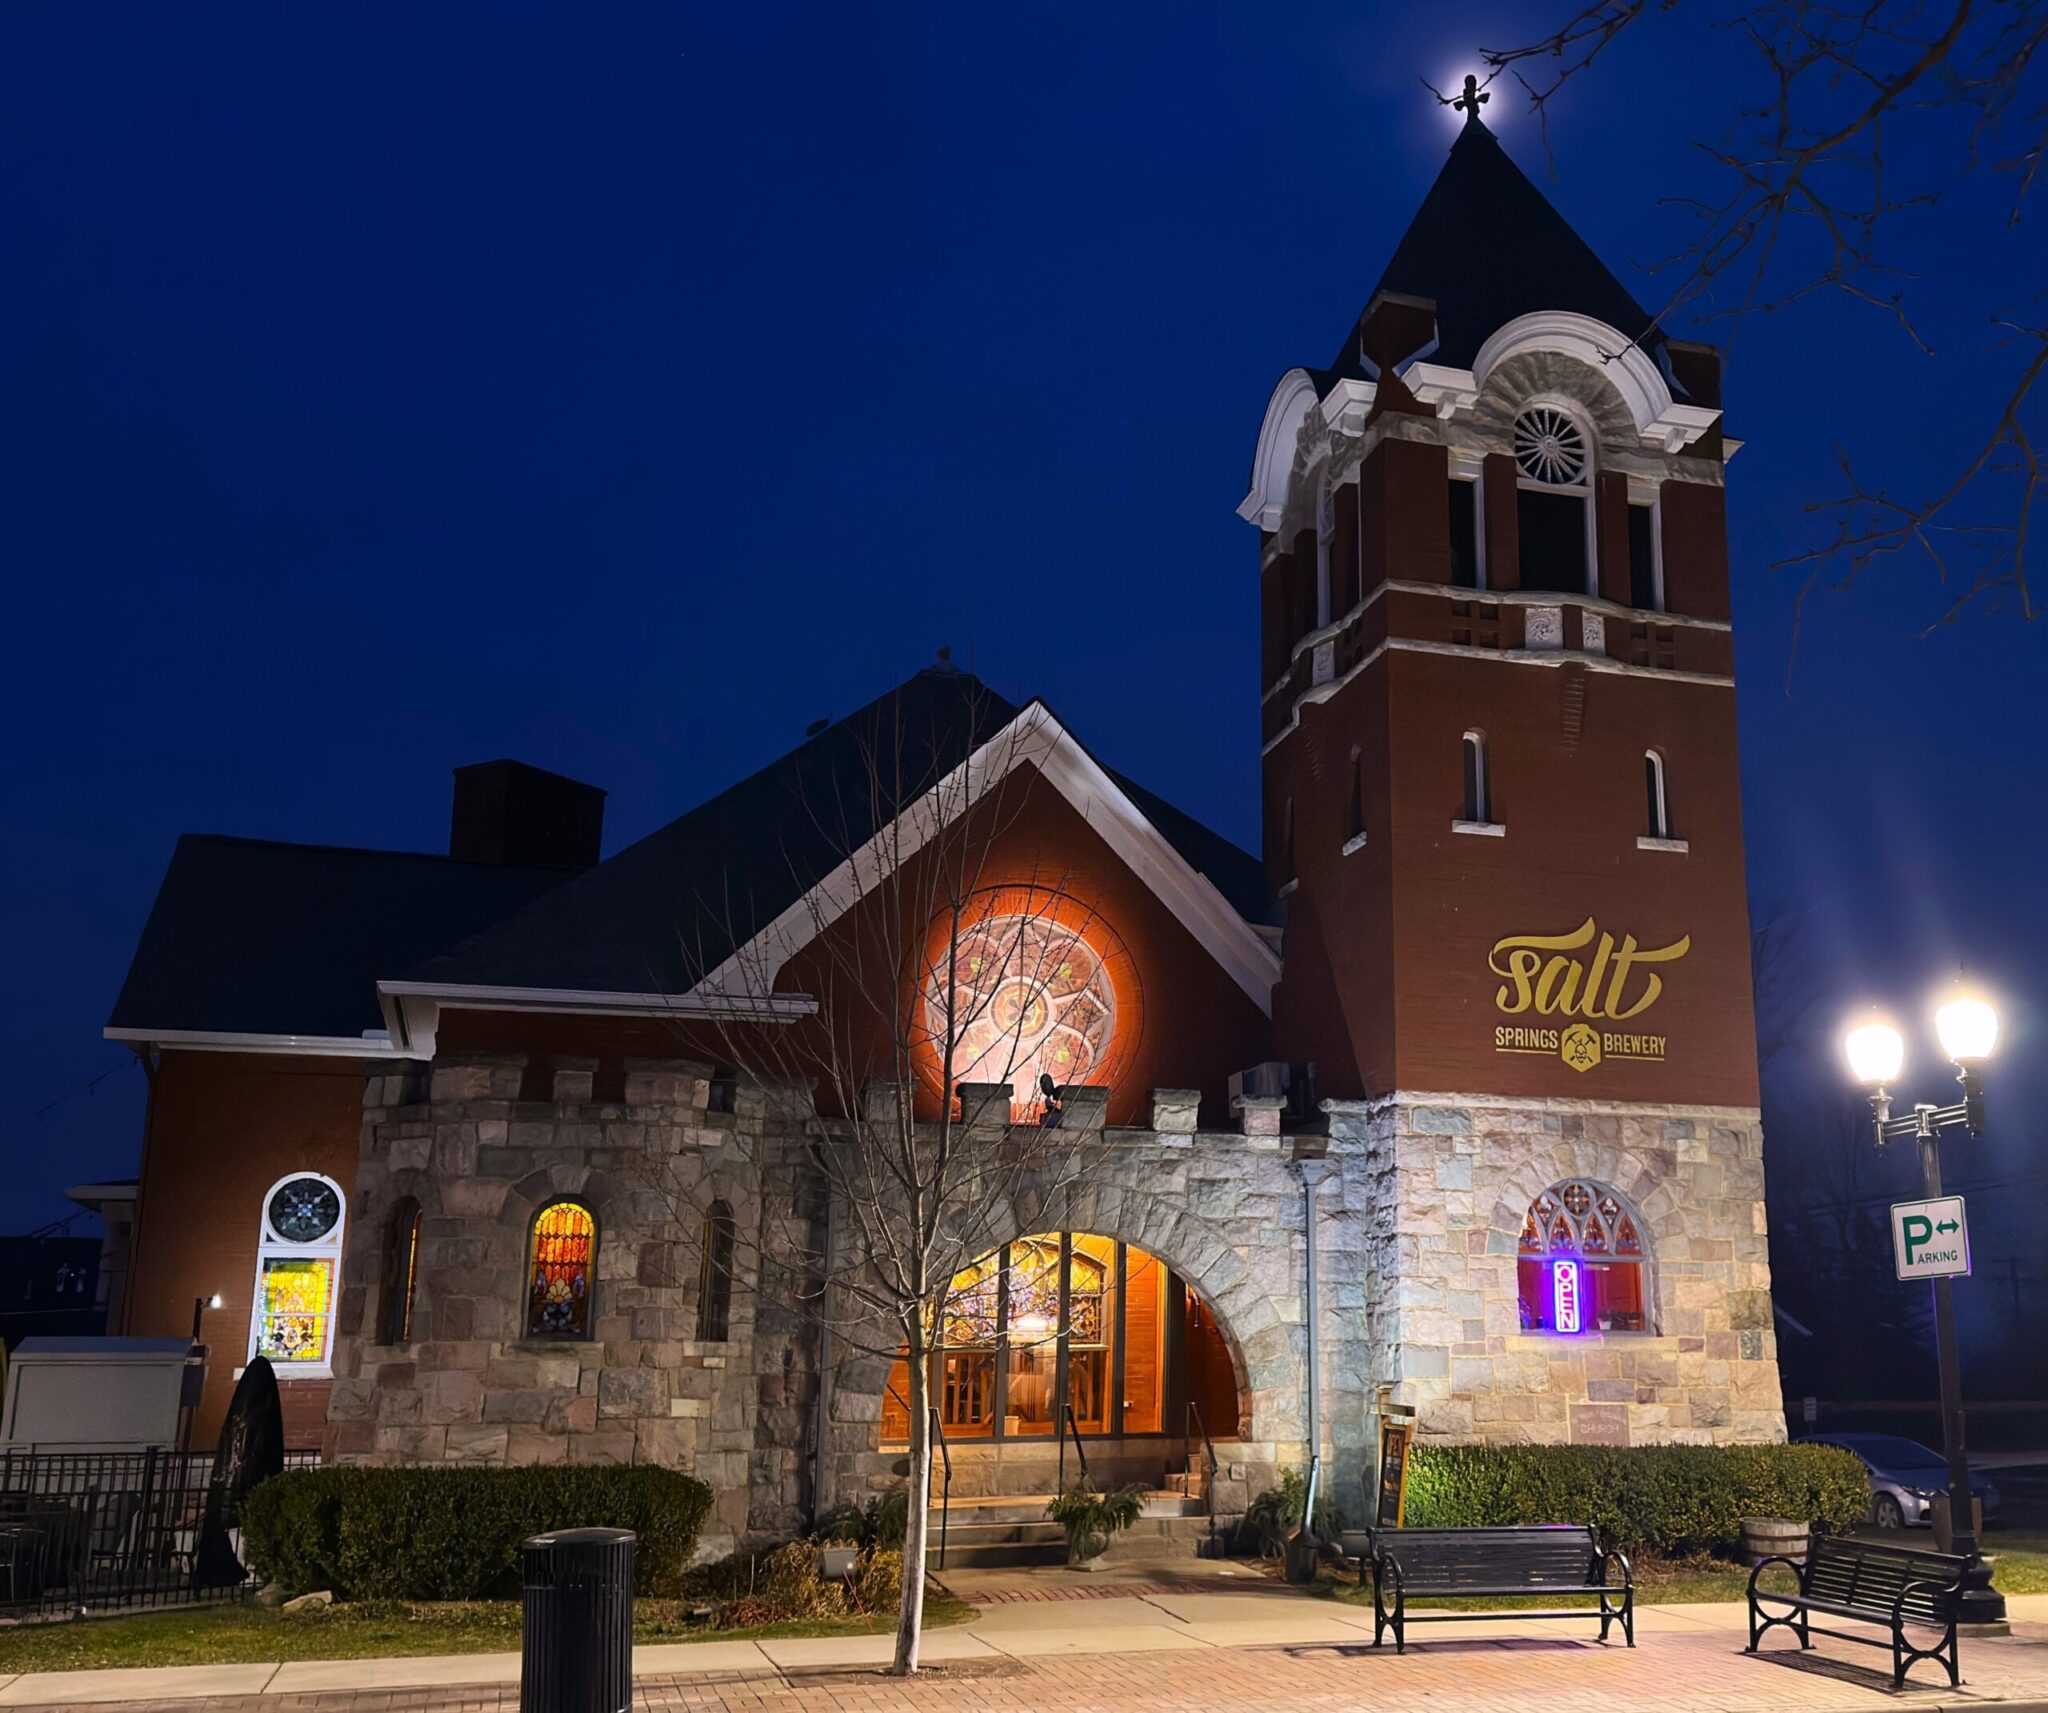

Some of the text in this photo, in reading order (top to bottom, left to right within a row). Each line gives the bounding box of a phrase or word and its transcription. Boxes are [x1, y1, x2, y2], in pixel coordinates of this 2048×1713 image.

[1488, 916, 1691, 1020] Salt
[1495, 1026, 1667, 1056] SPRINGS BREWERY
[1558, 1265, 1575, 1329] OPEN
